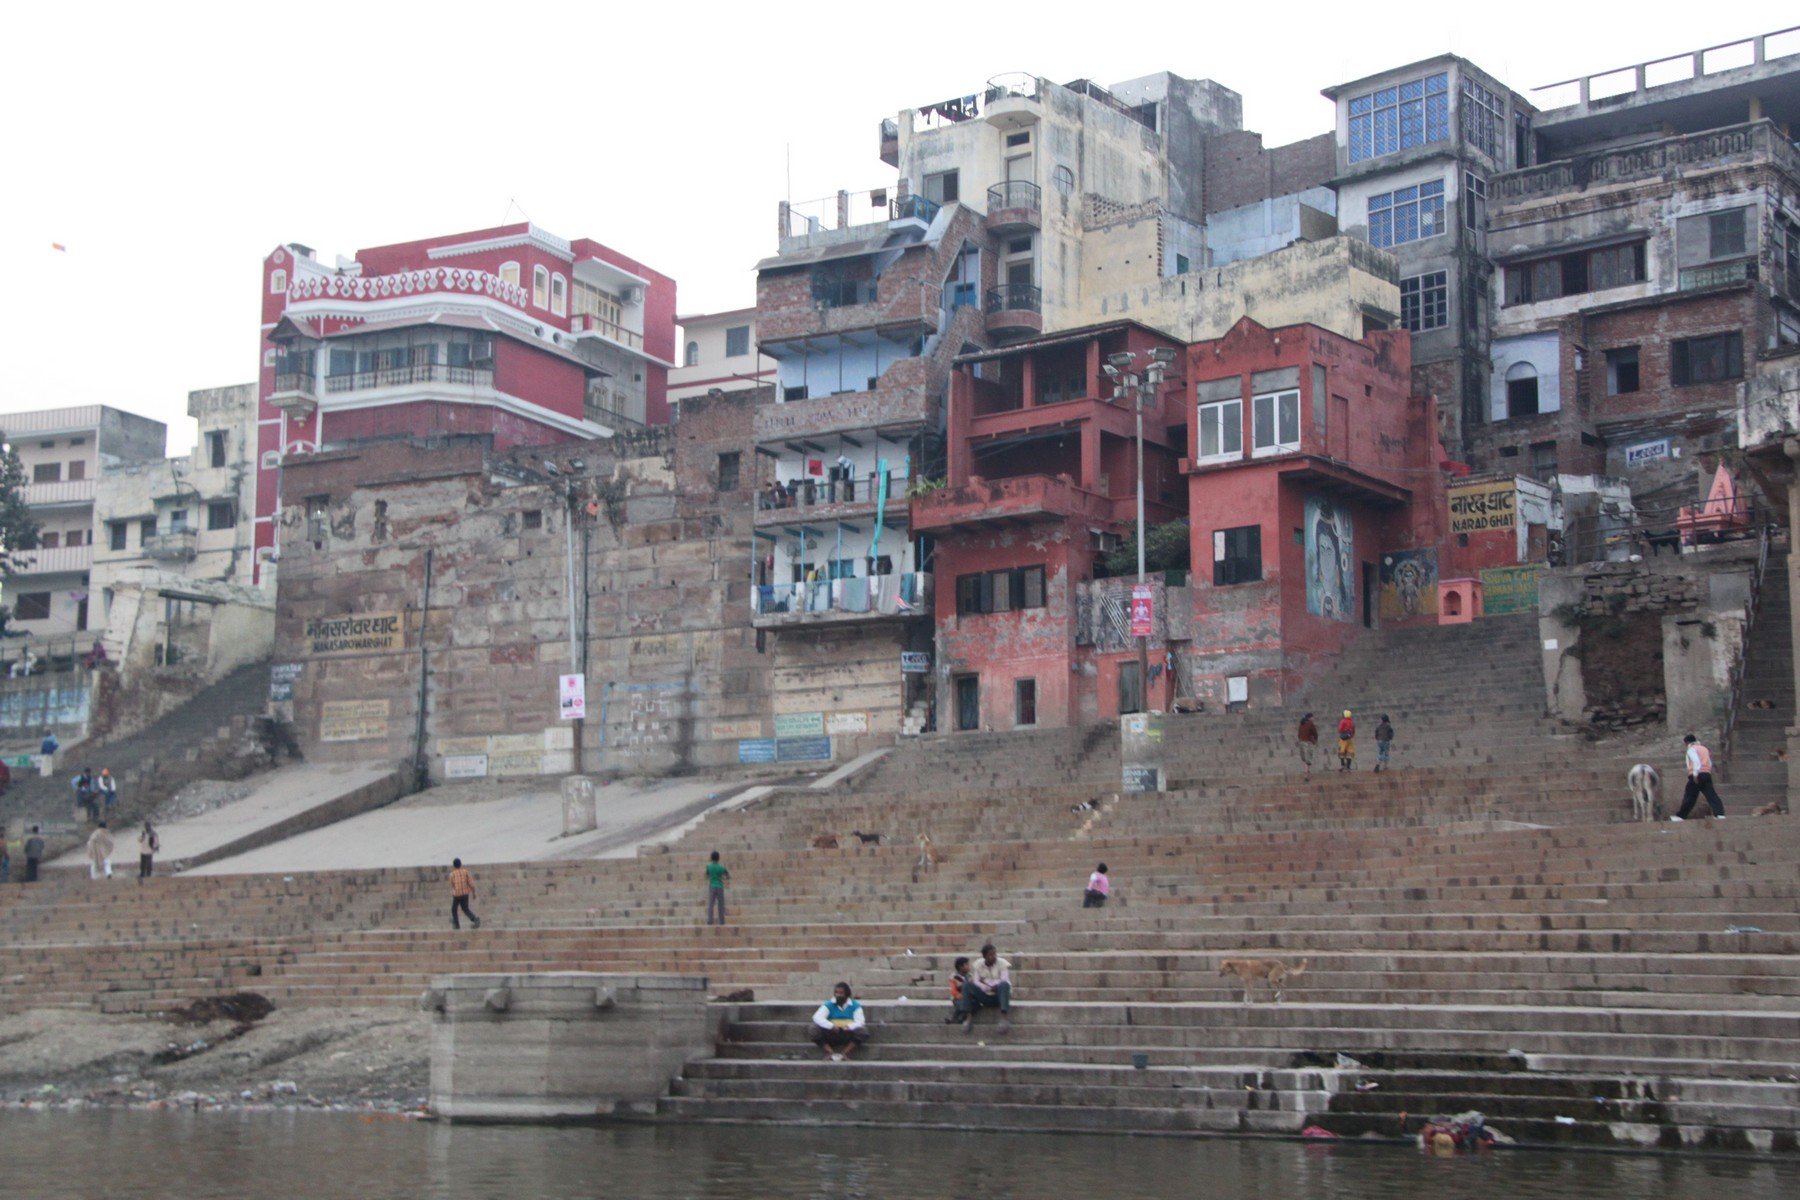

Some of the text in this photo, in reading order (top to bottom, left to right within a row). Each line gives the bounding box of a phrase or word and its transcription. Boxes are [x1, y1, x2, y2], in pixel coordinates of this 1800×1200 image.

[1451, 490, 1514, 515] नारद घाट
[1453, 513, 1515, 532] NARAD GHAT
